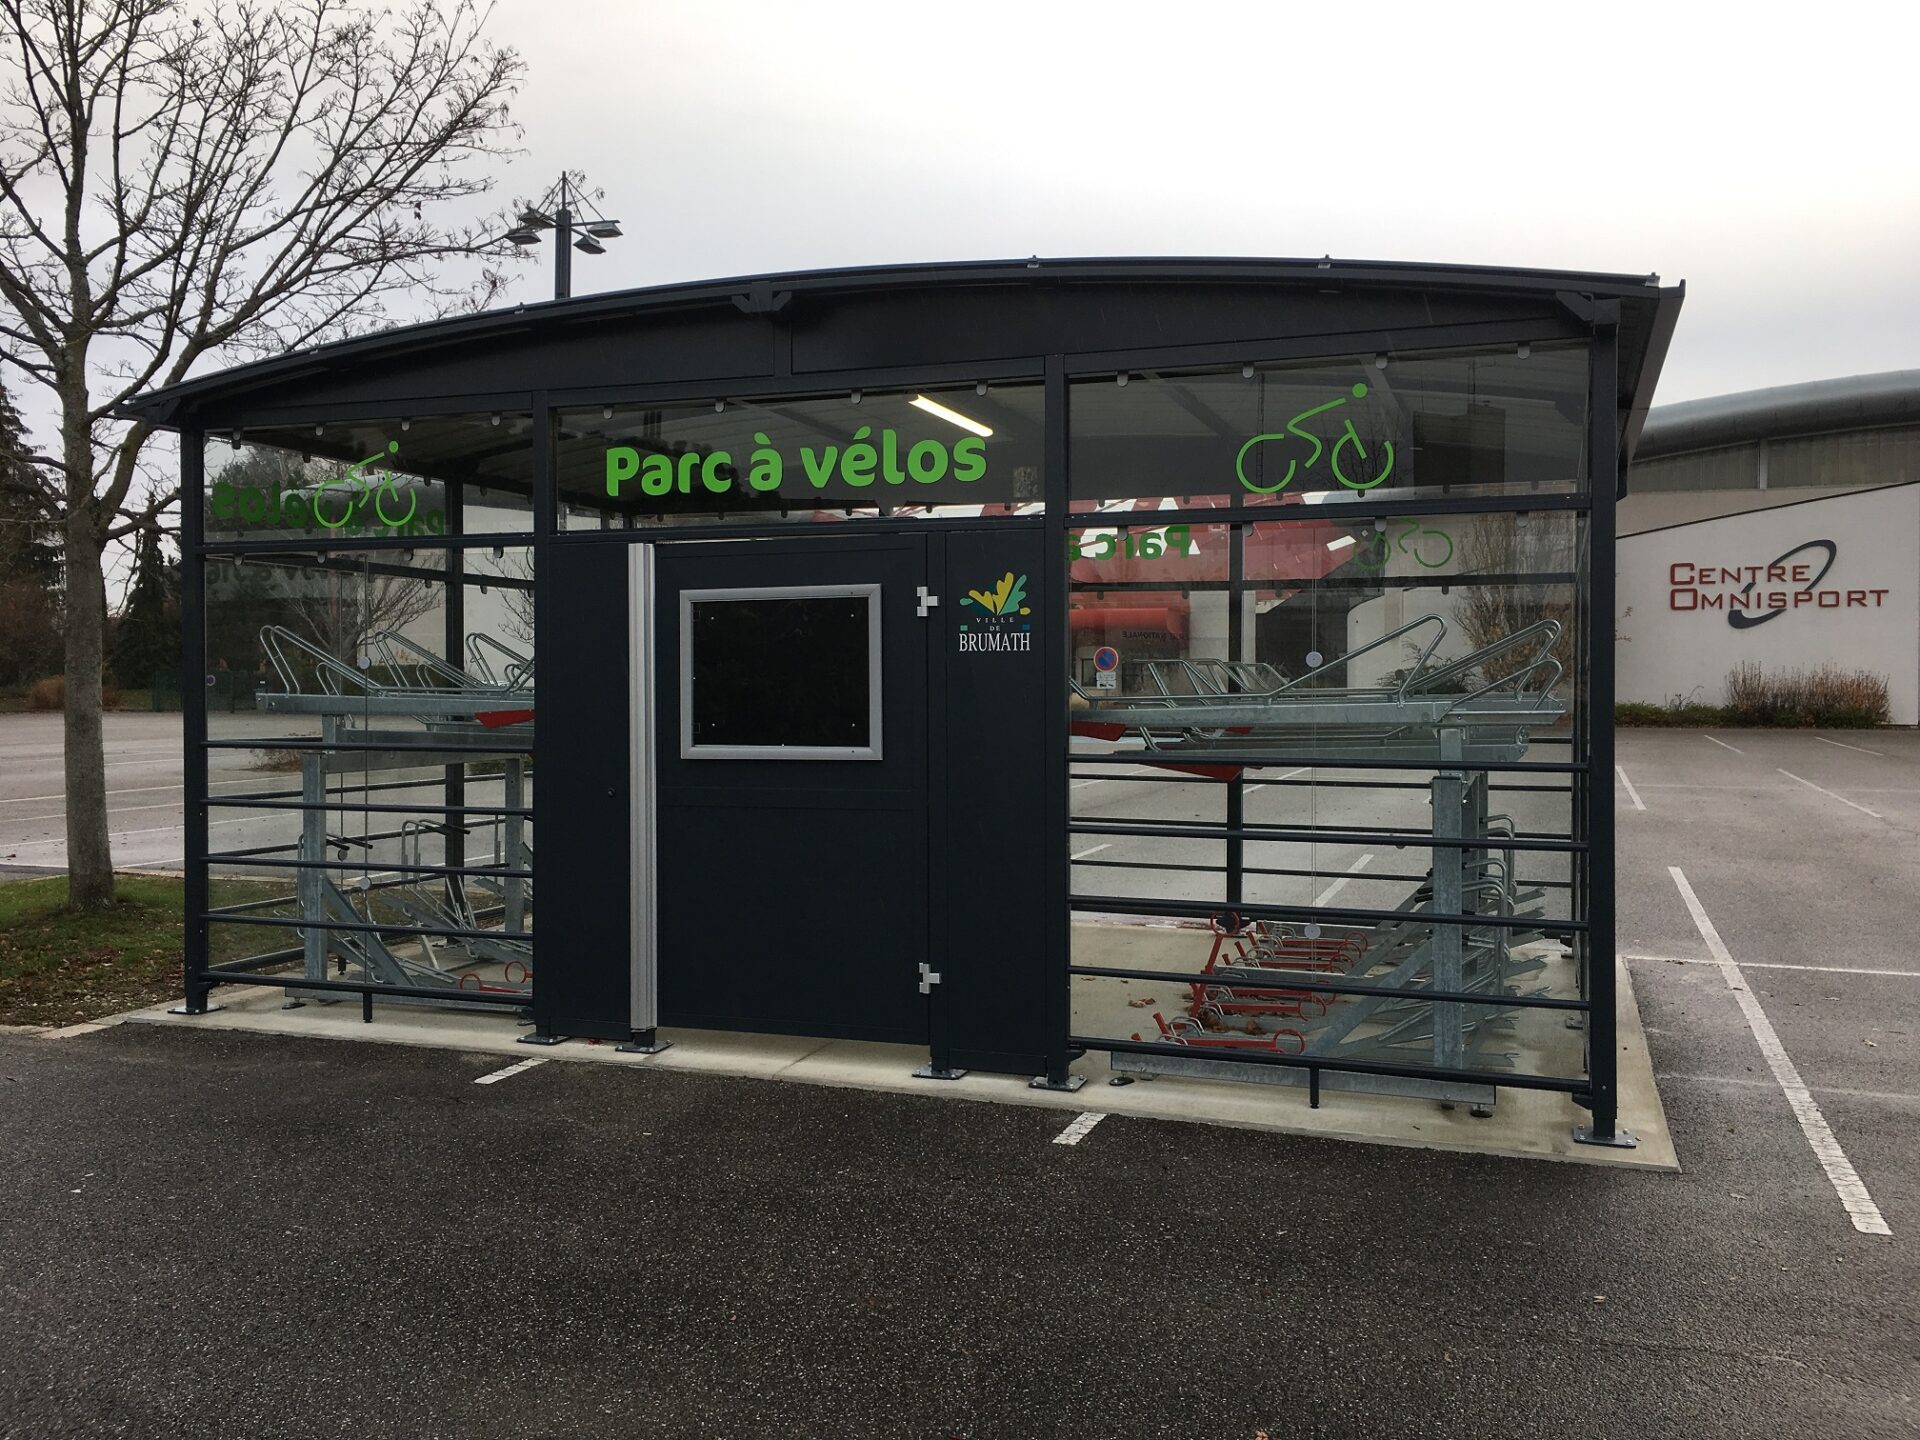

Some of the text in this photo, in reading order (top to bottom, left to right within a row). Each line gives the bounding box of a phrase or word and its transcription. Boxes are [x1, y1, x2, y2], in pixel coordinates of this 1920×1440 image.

[606, 425, 987, 497] Parc à vélos
[1670, 562, 1811, 586] CENTRE
[1670, 588, 1890, 611] OMNISPORT
[959, 632, 1031, 652] BRUMATH
